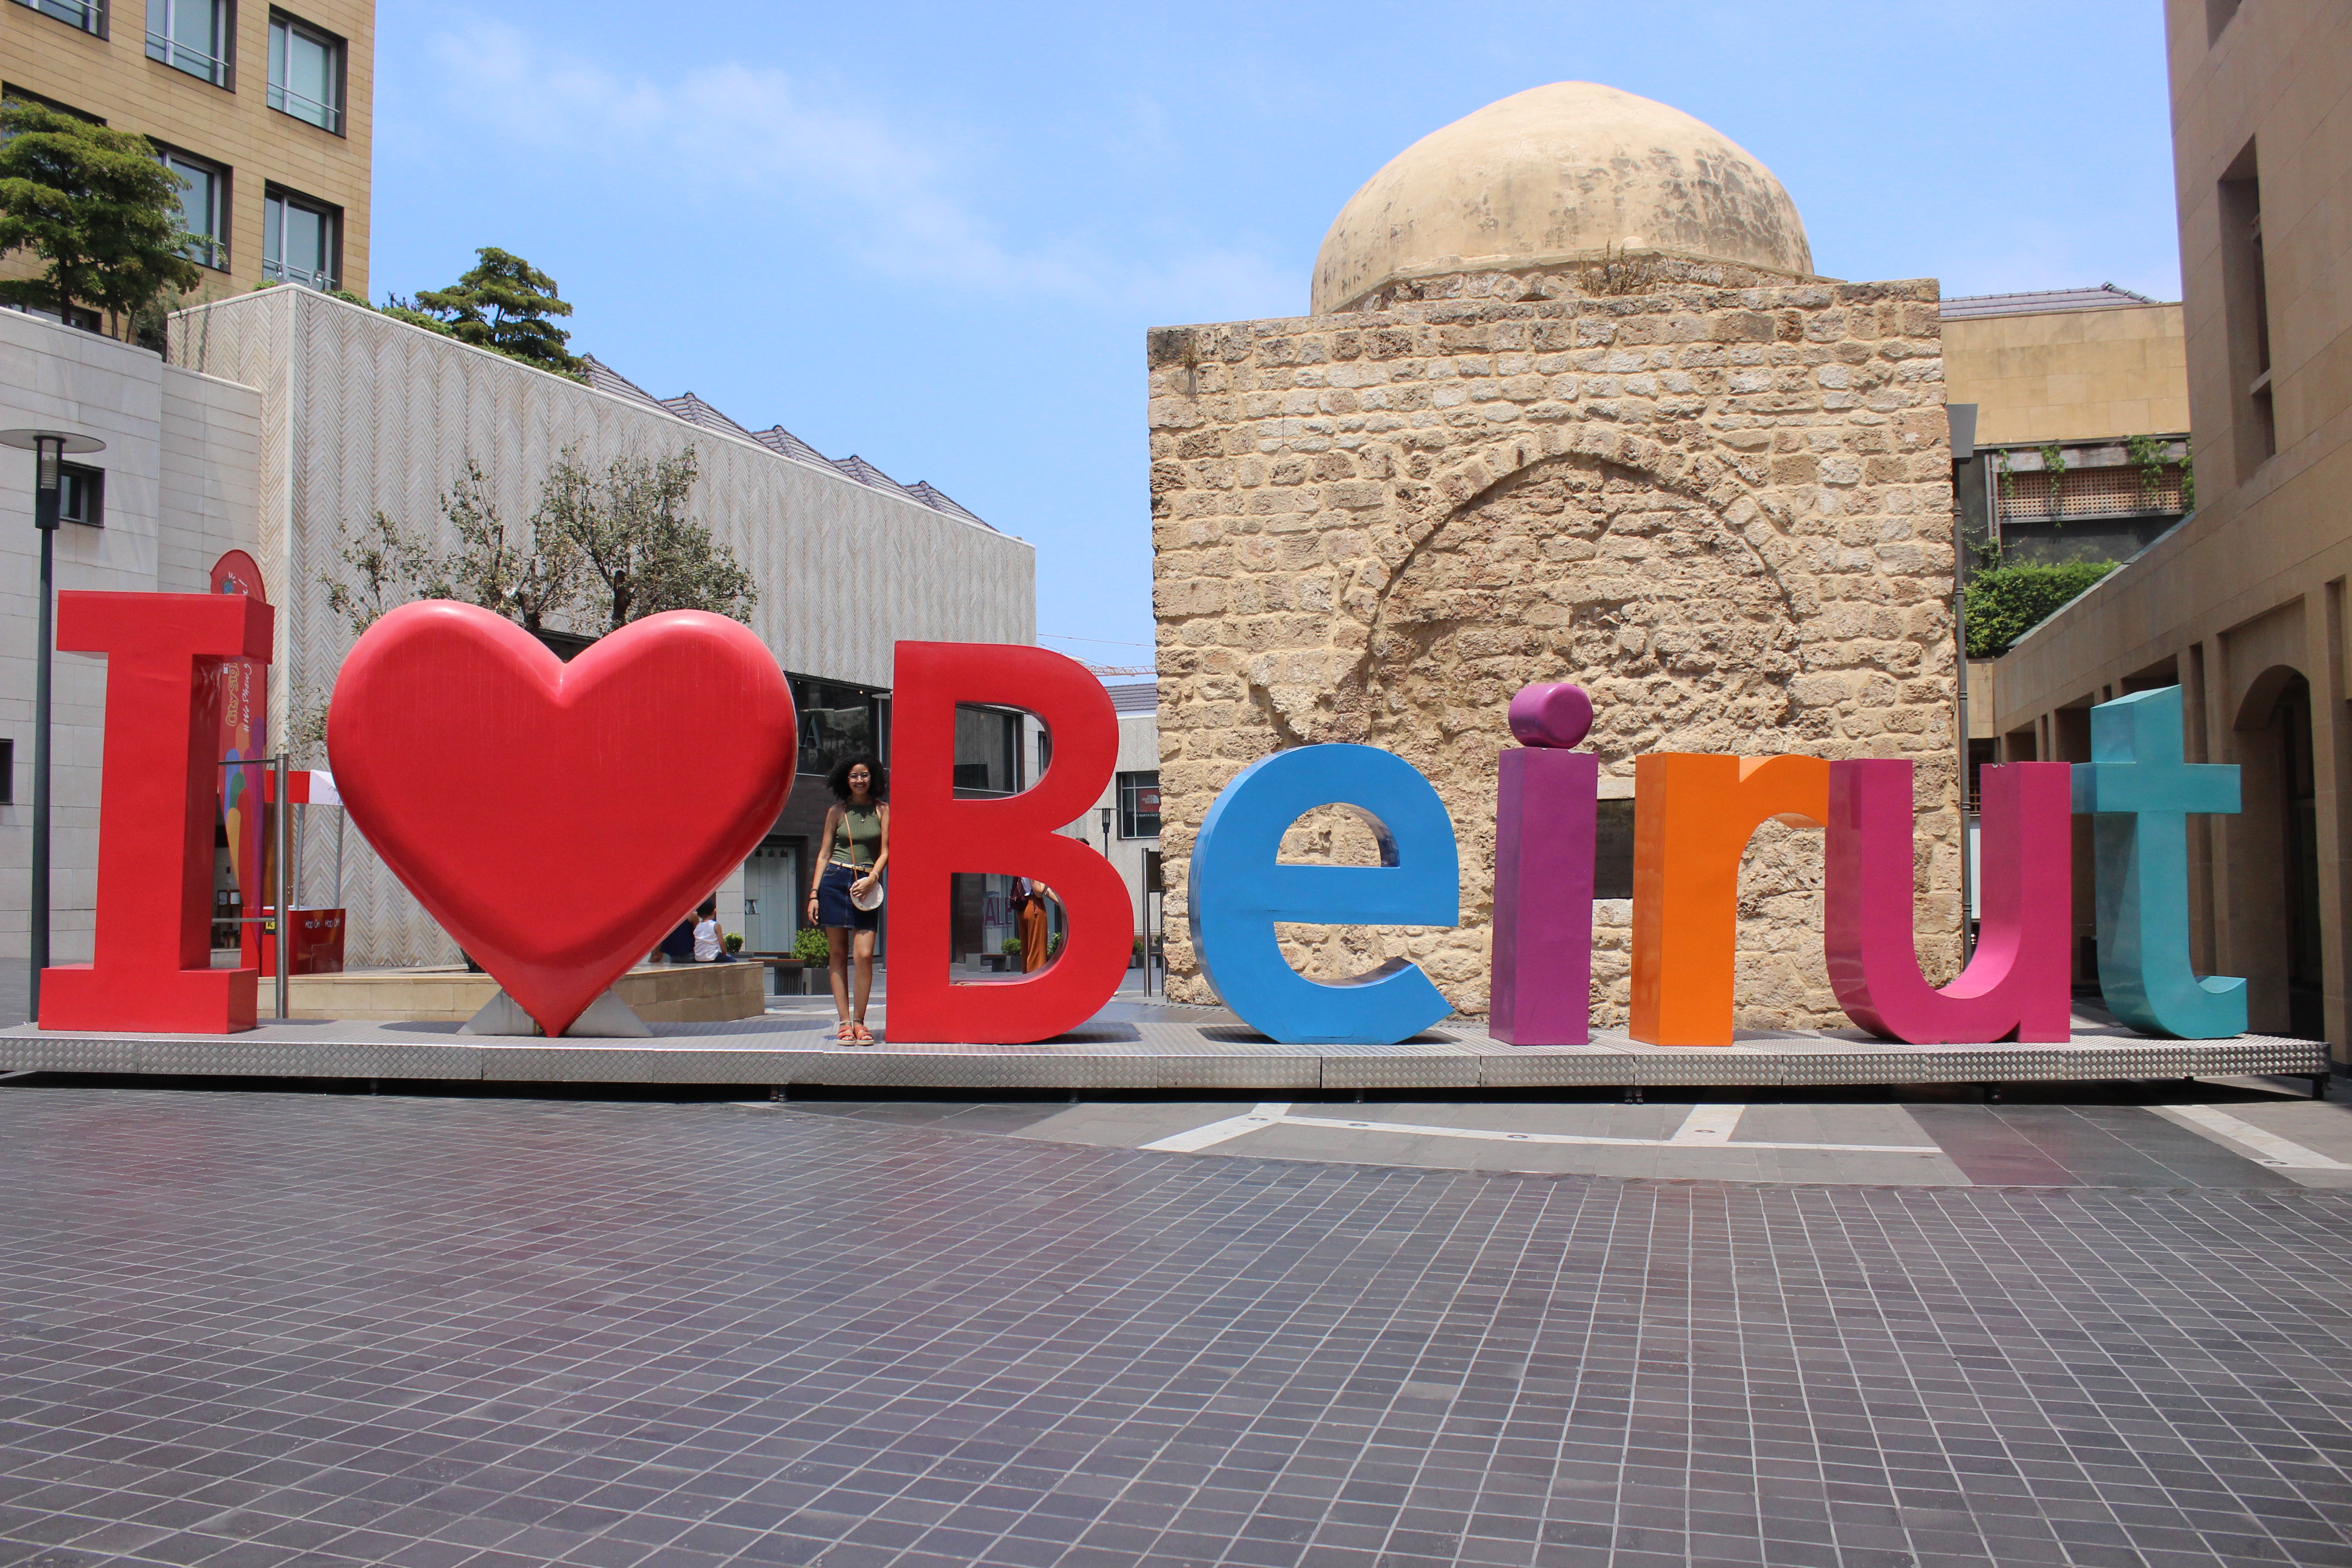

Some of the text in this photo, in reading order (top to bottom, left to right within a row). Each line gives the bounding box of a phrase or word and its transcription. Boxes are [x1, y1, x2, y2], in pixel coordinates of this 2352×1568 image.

[39, 590, 2248, 1046] I Beirut
[305, 920, 314, 929] Hop
[314, 919, 320, 928] On
[983, 897, 1012, 926] ALE
